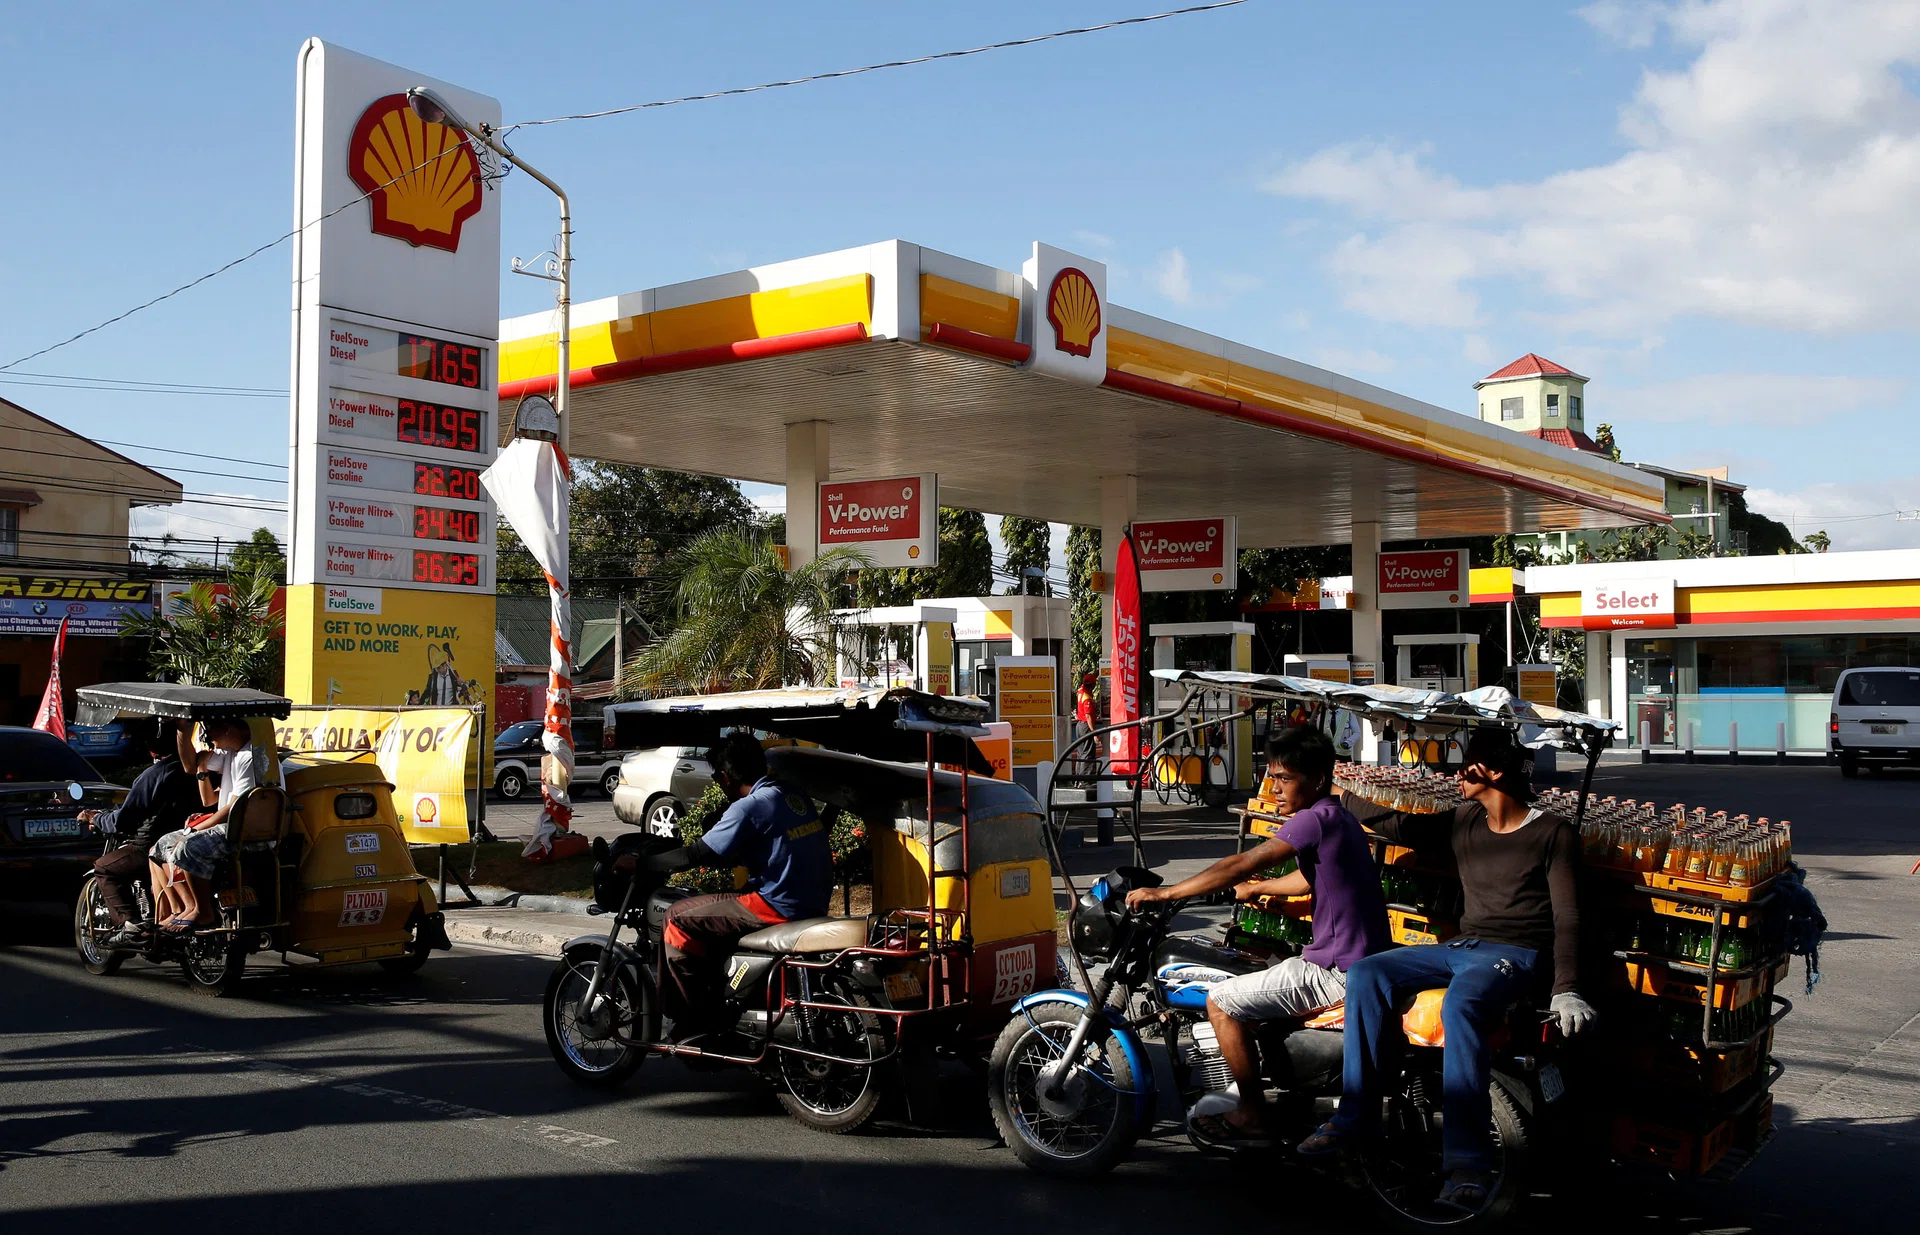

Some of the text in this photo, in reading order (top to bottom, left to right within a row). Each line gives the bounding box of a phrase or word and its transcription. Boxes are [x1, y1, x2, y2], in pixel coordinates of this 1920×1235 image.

[330, 330, 369, 347] FuelSave
[330, 346, 356, 361] Diesel
[408, 337, 478, 387] 17.65
[330, 398, 395, 418] V-Power Nitro+
[329, 414, 354, 429] Diesel
[399, 400, 477, 451] 20.95
[329, 455, 368, 471] FuelSave
[328, 469, 363, 483] Gasoline
[415, 466, 478, 500] 32.20
[828, 493, 843, 501] Shell
[329, 501, 394, 519] V-Power Nitro+
[828, 503, 908, 523] V-Power
[328, 515, 364, 528] Gasoline
[414, 508, 478, 543] 34.40
[829, 524, 889, 535] Performance Fuels
[327, 545, 394, 561] V-Power Nitro+
[1140, 539, 1213, 555] V-Power
[327, 559, 354, 575] Racing
[414, 553, 477, 585] 36.35
[1384, 567, 1449, 580] V-Power
[329, 589, 348, 598] Shell
[1322, 589, 1352, 598] HELI
[1596, 590, 1659, 609] Select
[69, 604, 84, 613] KIA
[328, 598, 375, 611] FuelSave
[42, 618, 87, 627] Vulcaizing,
[324, 620, 461, 641] GET TO WORK, PLAY,
[324, 637, 400, 653] AND MORE
[929, 673, 949, 684] EURO
[360, 838, 377, 848] 1470
[346, 892, 383, 909] PLTODA
[342, 909, 381, 925] 143
[999, 949, 1034, 977] CCTODA
[1165, 970, 1227, 984] BARAKO
[995, 972, 1032, 1000] 258
